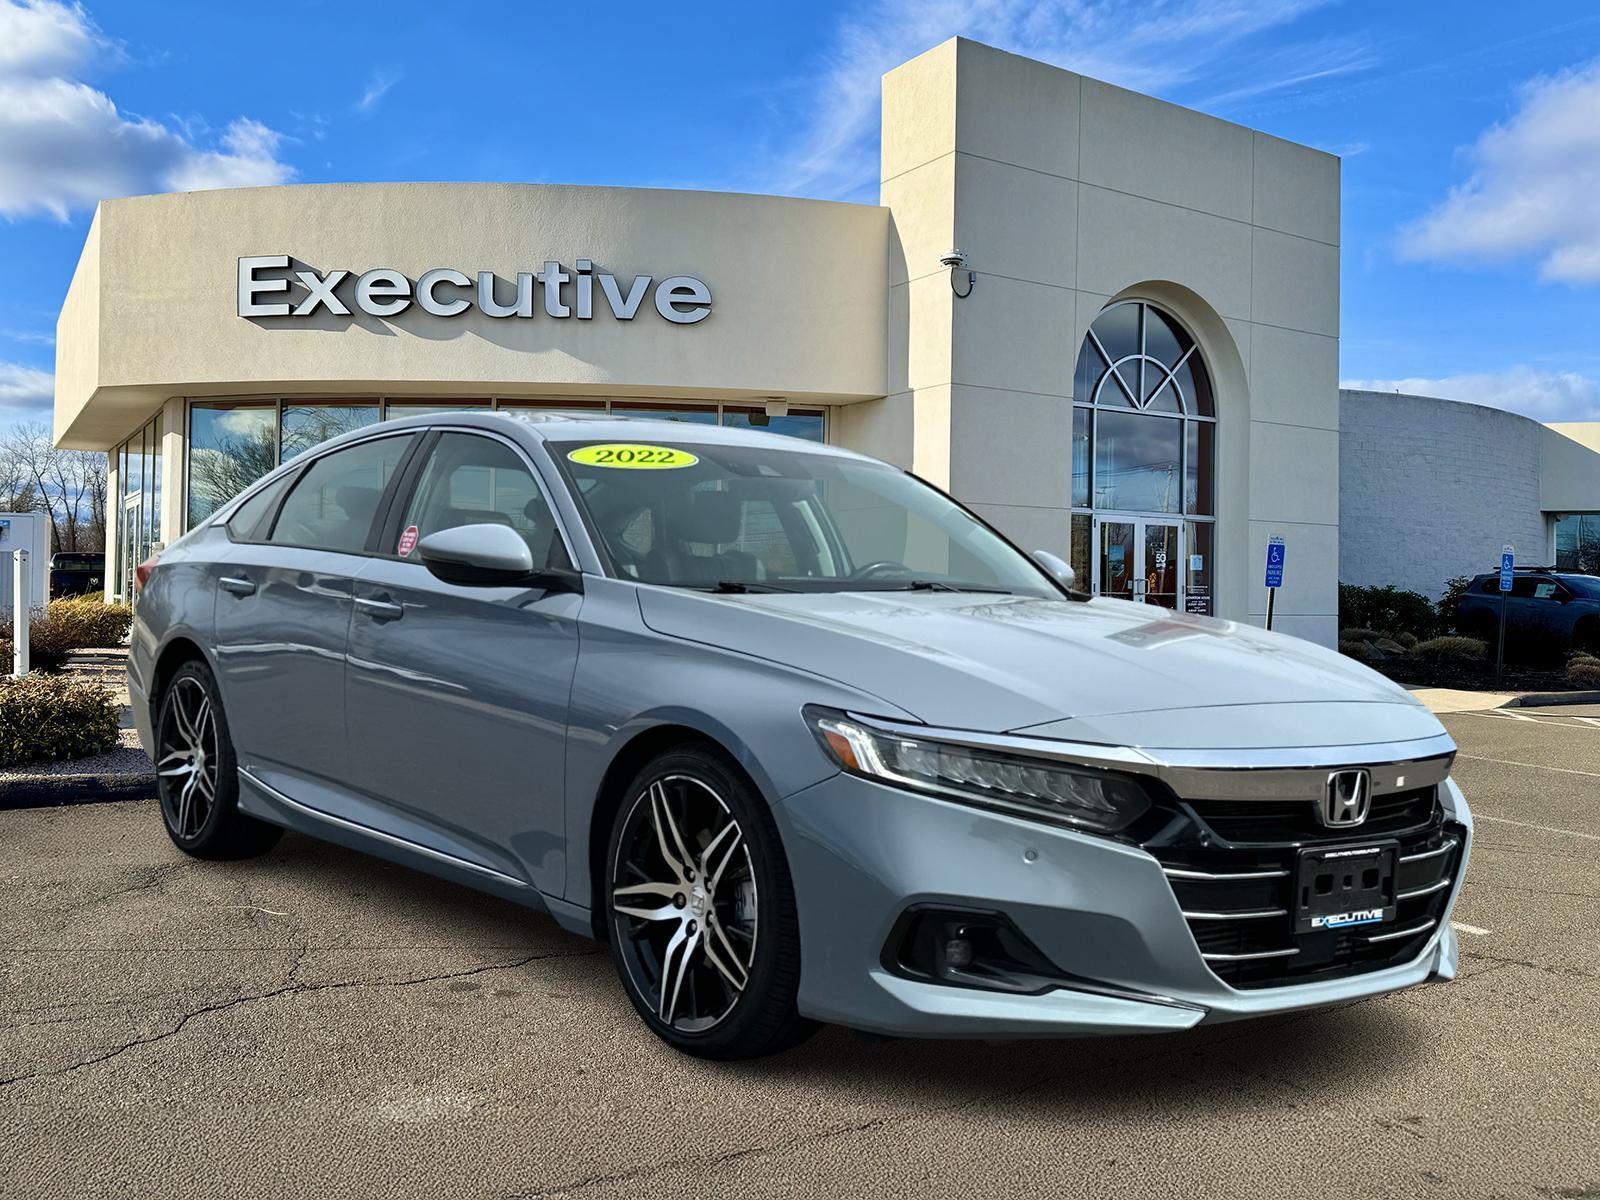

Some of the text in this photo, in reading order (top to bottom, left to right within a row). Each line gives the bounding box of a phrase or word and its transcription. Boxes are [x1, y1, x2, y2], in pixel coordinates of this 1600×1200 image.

[236, 254, 713, 325] Executive
[595, 449, 676, 464] 2022
[1311, 909, 1384, 928] EXECUTIVE
